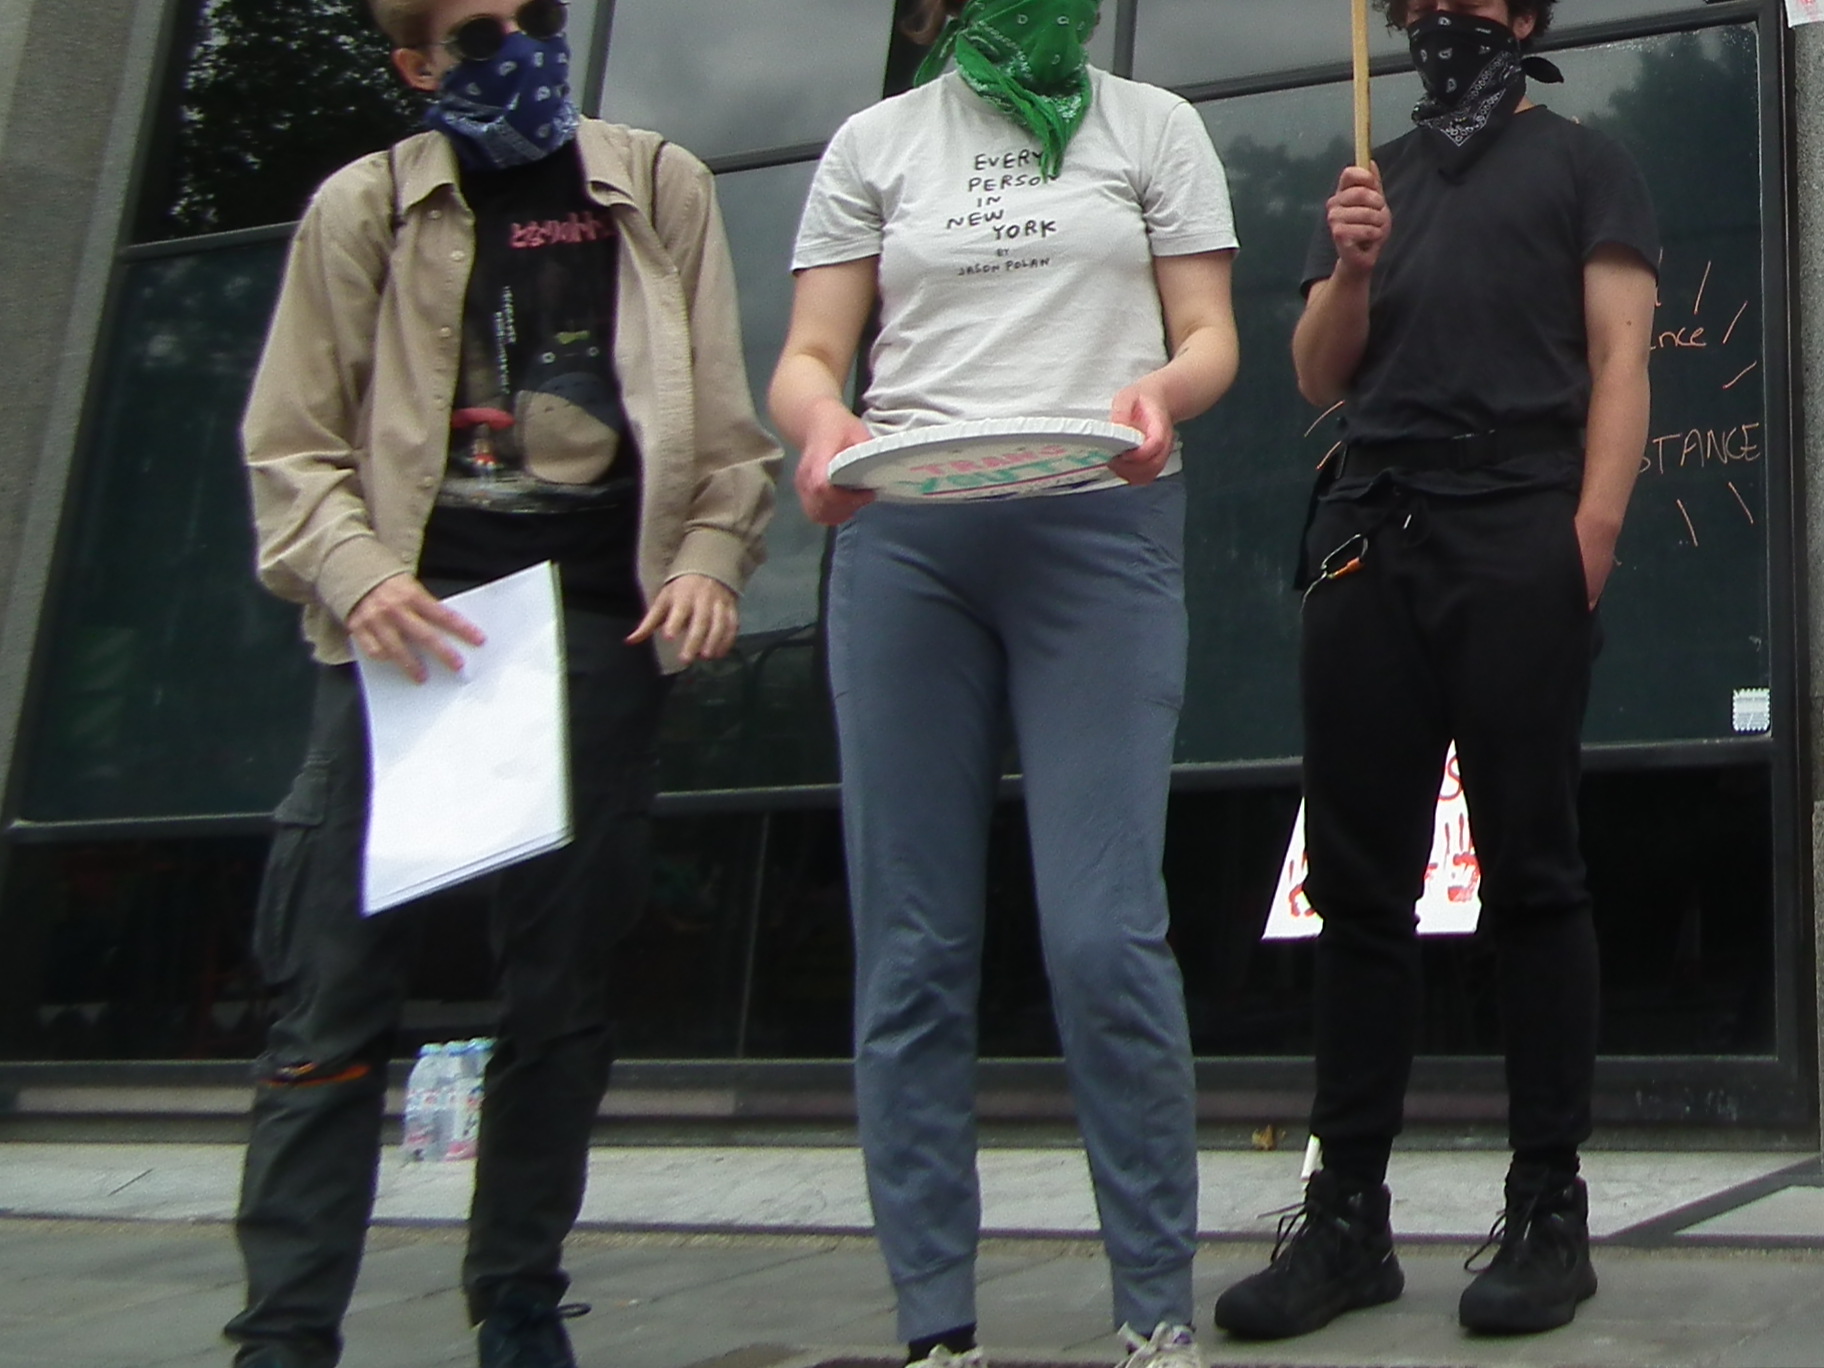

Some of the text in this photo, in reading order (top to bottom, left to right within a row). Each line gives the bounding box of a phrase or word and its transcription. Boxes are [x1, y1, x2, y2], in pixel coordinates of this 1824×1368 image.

[974, 149, 1043, 171] EVERY
[977, 196, 1002, 208] IN
[946, 209, 1005, 230] NEW
[992, 220, 1058, 240] YORK
[1650, 326, 1707, 351] nce
